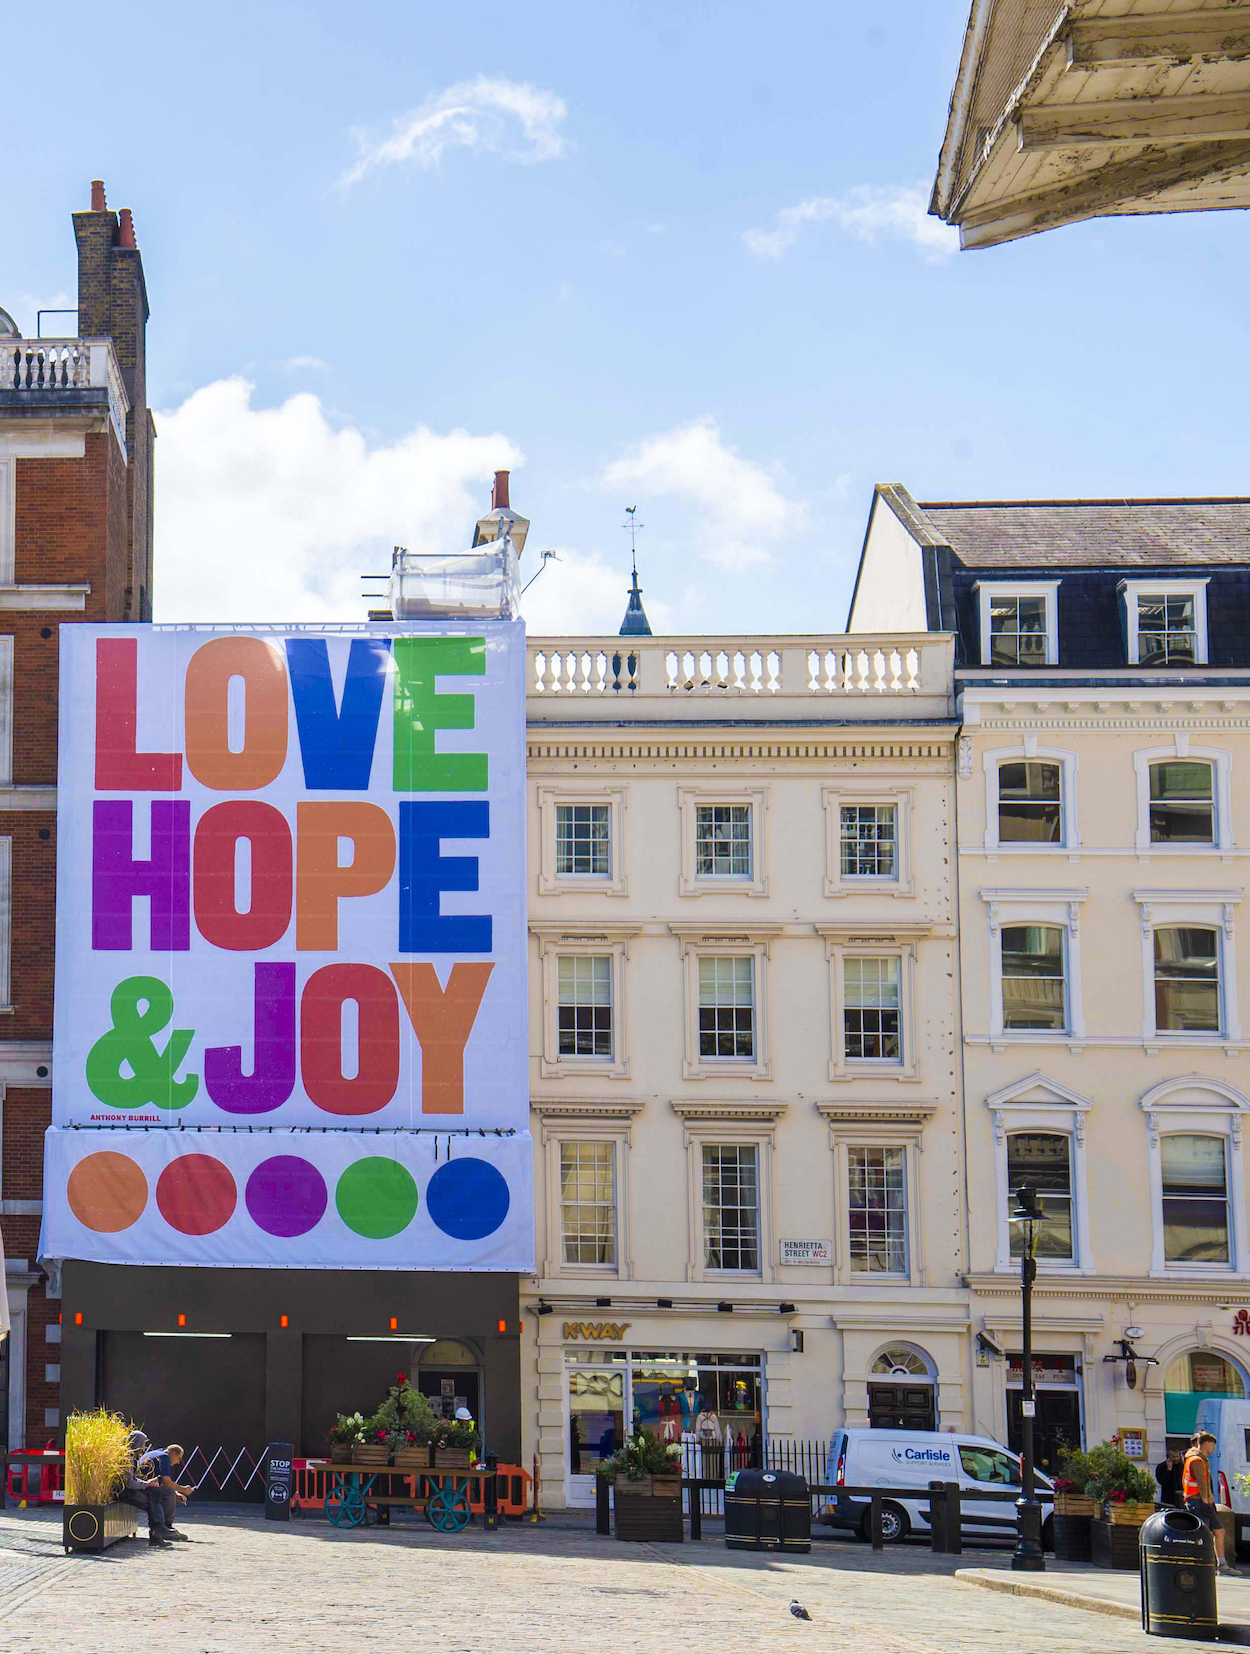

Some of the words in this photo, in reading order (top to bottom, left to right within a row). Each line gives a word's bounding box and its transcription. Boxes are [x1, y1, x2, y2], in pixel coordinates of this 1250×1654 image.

[94, 636, 489, 792] LOVE
[91, 800, 493, 953] HOPE
[86, 975, 199, 1111] &
[204, 962, 496, 1115] JOY
[905, 1448, 950, 1460] Carlisle
